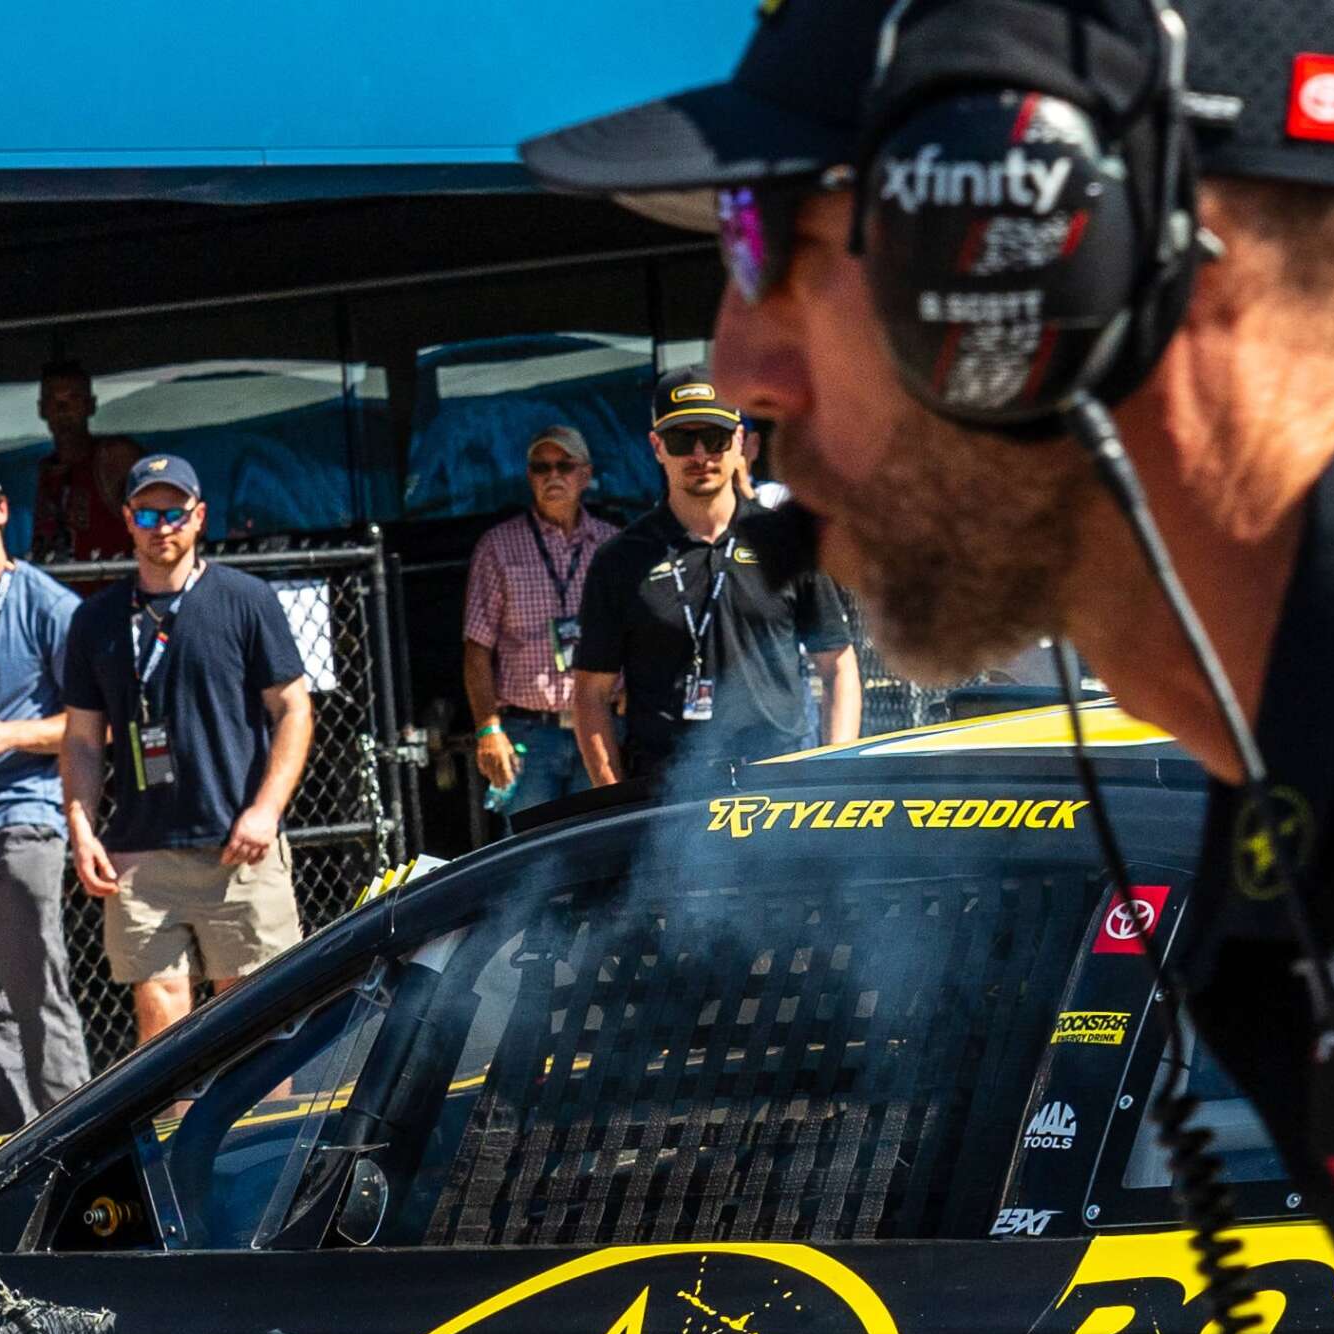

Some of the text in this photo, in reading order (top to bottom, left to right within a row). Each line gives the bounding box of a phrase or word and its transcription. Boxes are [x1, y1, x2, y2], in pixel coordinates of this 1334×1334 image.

[879, 142, 1073, 216] xfinity
[761, 800, 895, 829] TYLER
[901, 800, 1091, 829] REDDICK
[1025, 1101, 1077, 1136] MAC
[1023, 1136, 1073, 1149] TOOLS
